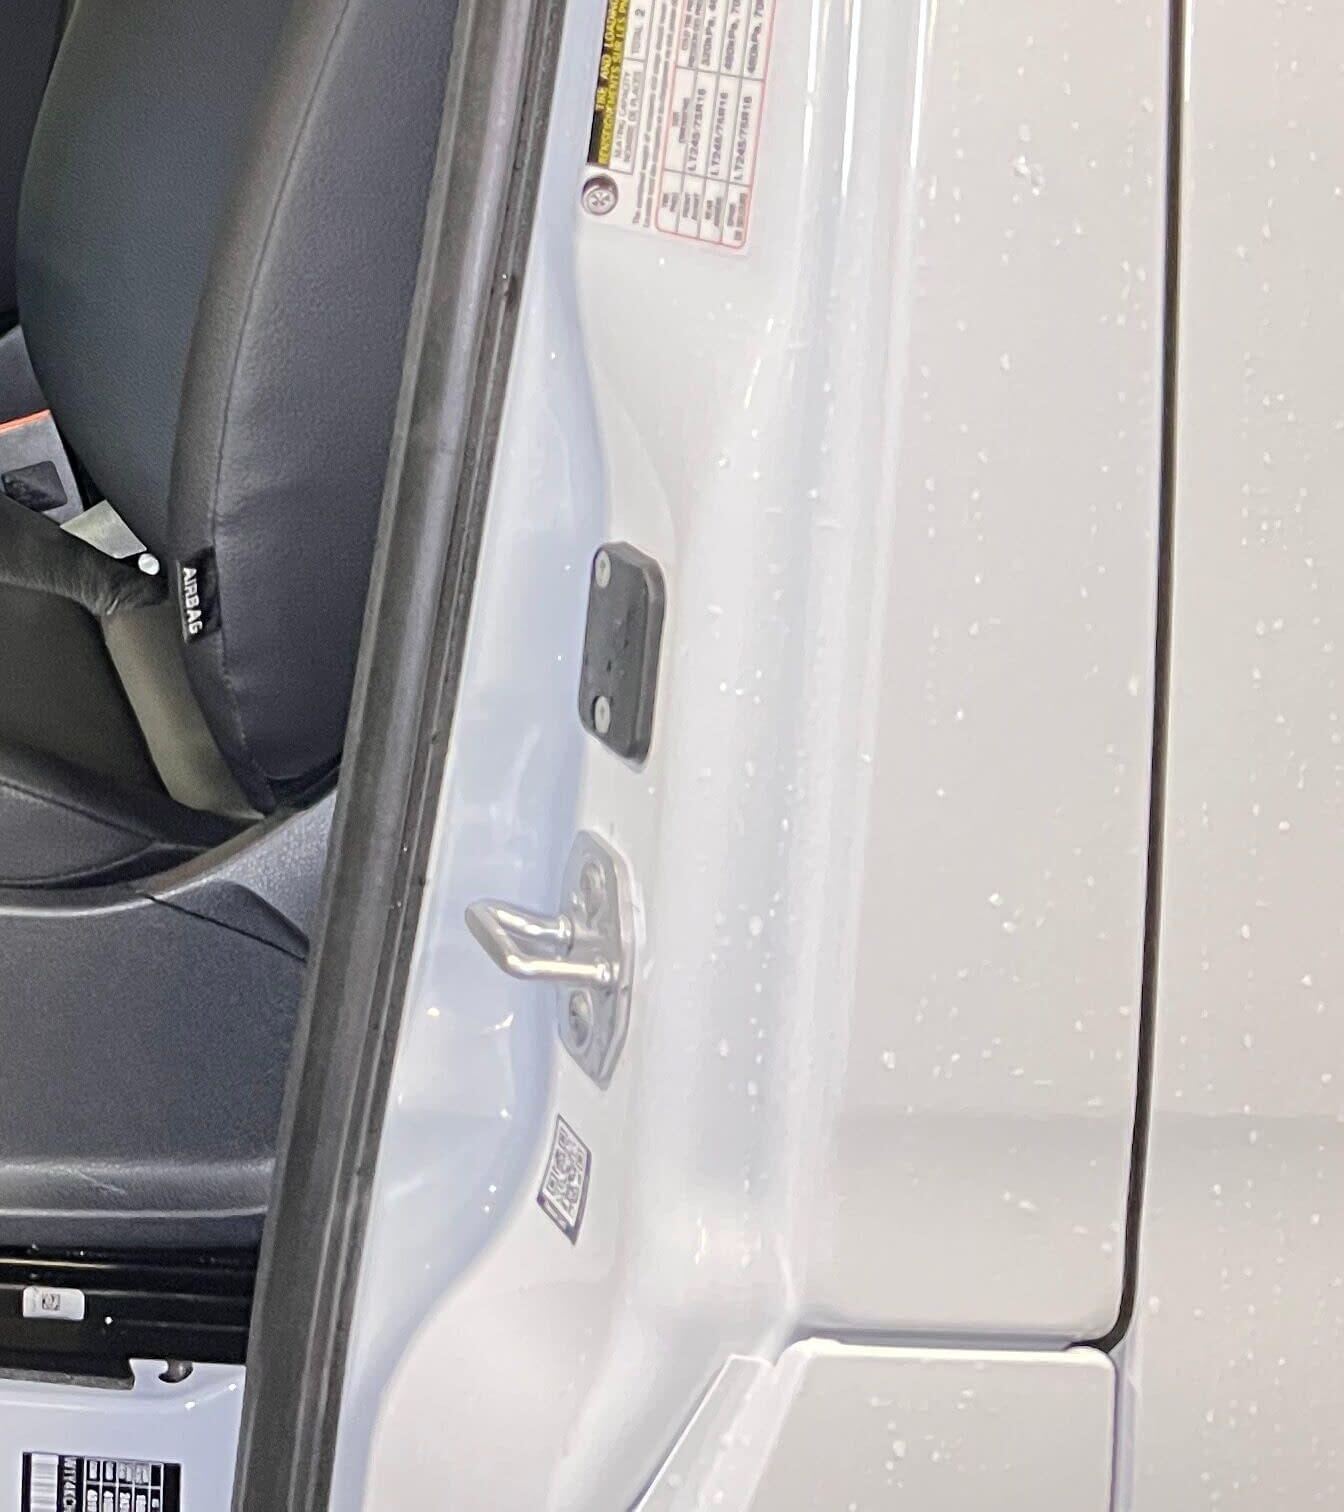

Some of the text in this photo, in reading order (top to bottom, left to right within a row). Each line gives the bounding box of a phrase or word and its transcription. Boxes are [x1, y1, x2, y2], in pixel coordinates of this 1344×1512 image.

[634, 8, 645, 16] 2
[599, 54, 611, 79] AND
[183, 568, 203, 634] AIRBAG
